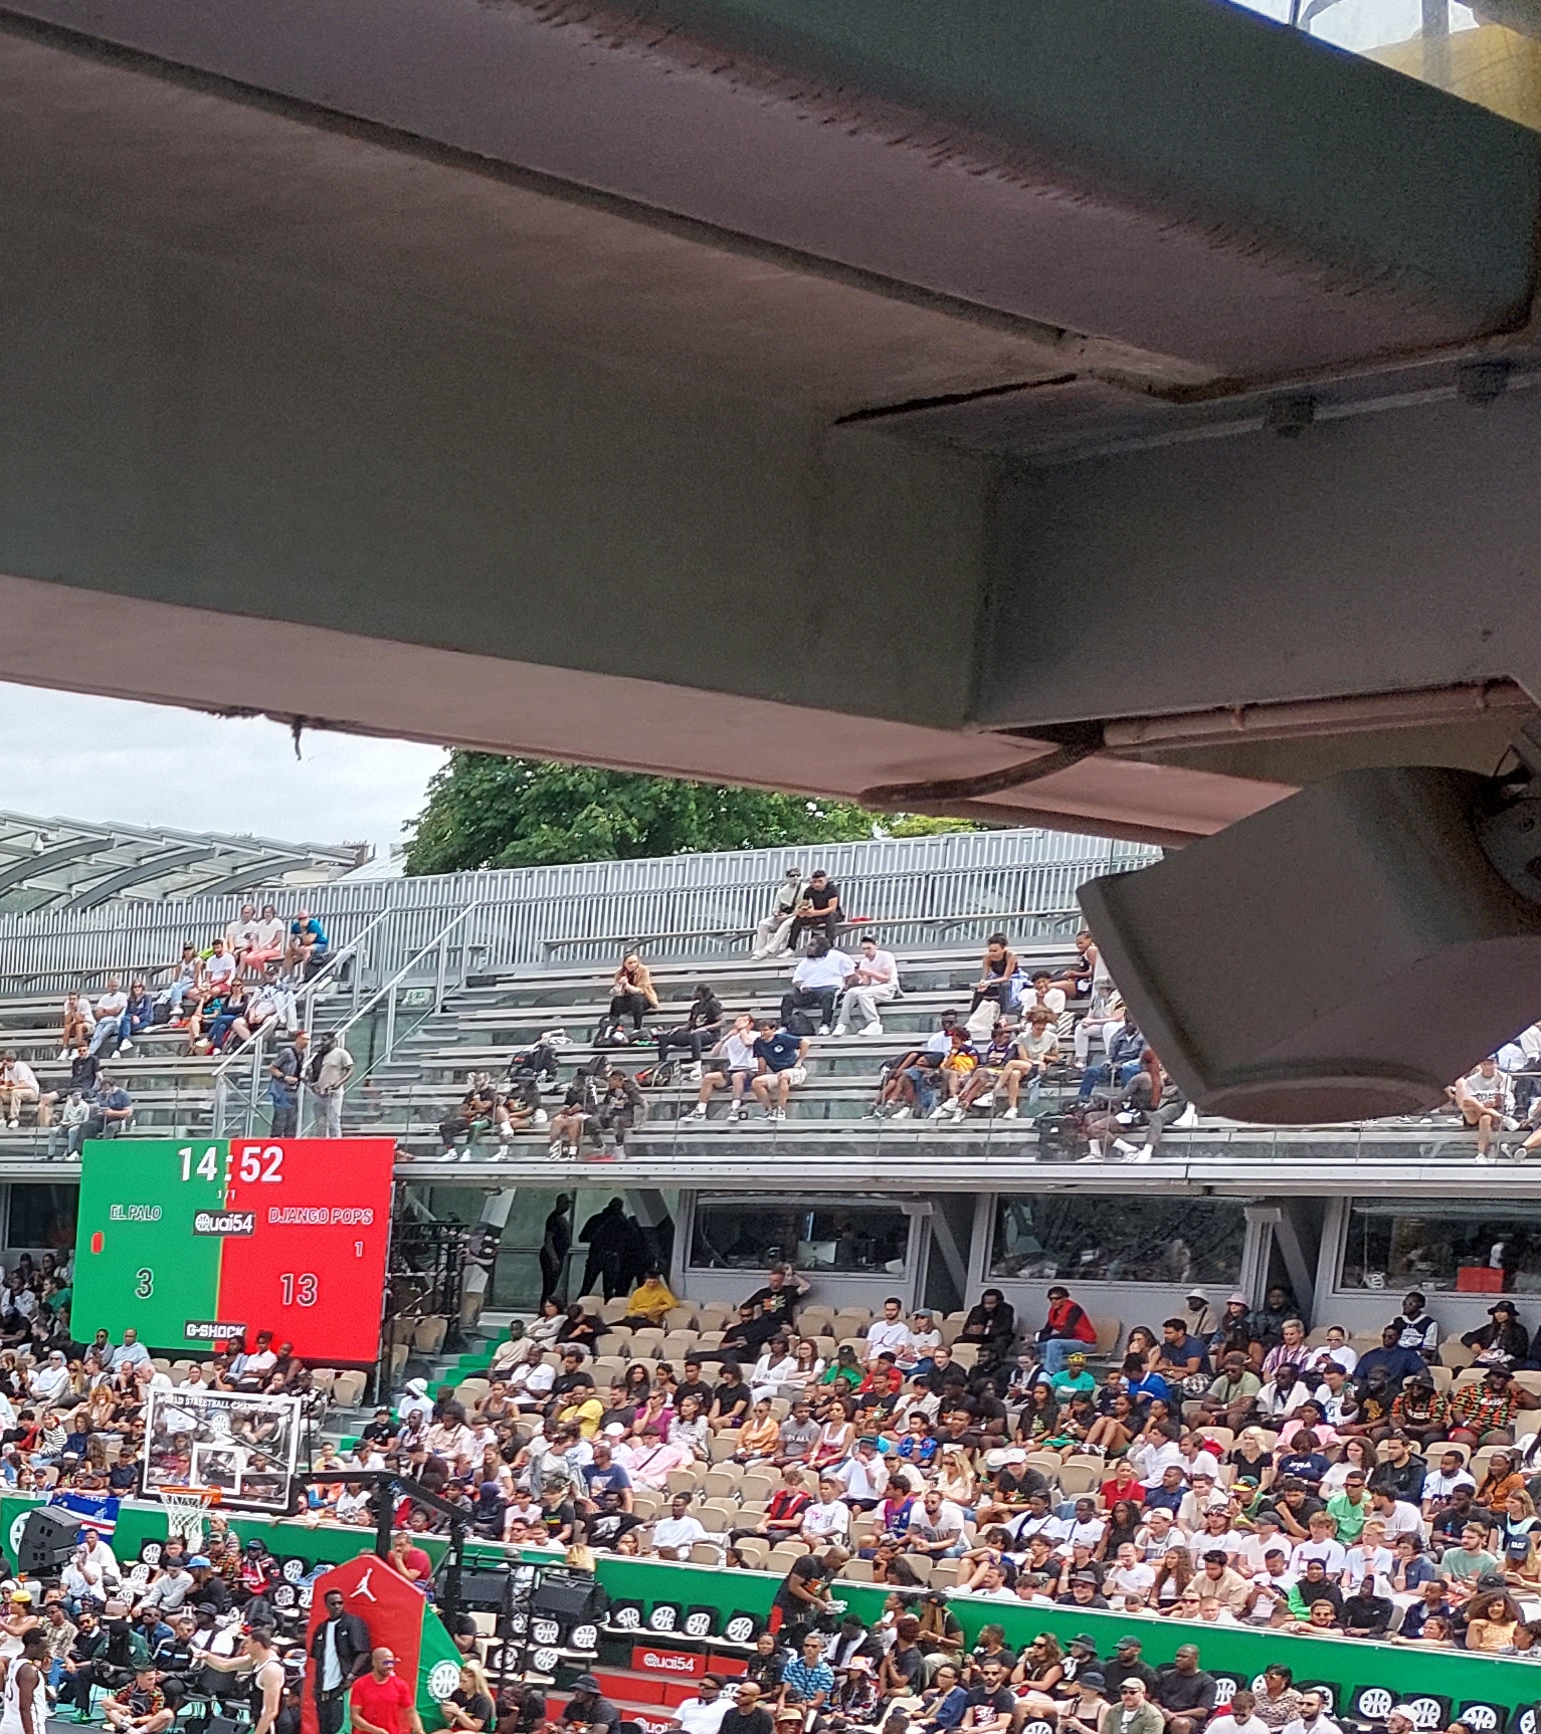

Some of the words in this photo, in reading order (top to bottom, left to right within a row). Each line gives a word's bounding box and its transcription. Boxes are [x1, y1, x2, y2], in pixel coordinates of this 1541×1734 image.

[178, 1146, 284, 1182] 14:52
[110, 1204, 126, 1220] EL
[128, 1204, 163, 1221] PALO
[195, 1212, 253, 1233] Quai54
[269, 1207, 329, 1224] DJANGO
[331, 1208, 374, 1226] POPS
[135, 1268, 154, 1299] 3
[280, 1273, 319, 1306] 13
[186, 1323, 246, 1338] G-SHOCK
[643, 1653, 695, 1671] Quai54
